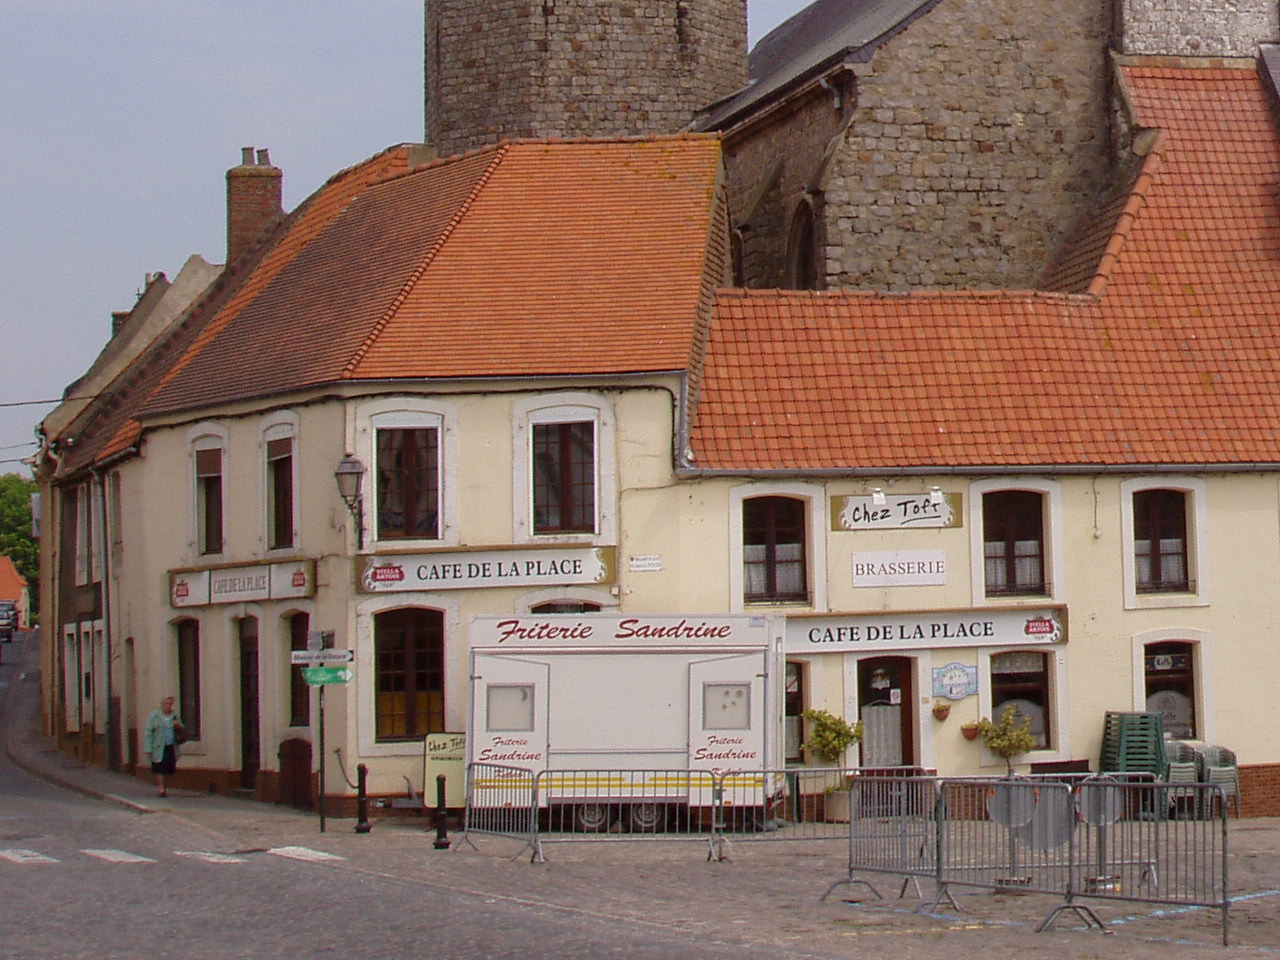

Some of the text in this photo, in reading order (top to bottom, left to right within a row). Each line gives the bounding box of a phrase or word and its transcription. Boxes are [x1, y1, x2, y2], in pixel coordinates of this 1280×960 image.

[852, 503, 892, 523] Chez
[417, 559, 583, 581] CAFE DE LA PLACE
[855, 560, 945, 576] BRASSERIE
[496, 618, 732, 644] Friterie Sandrine
[808, 622, 994, 643] CAFE DE LA PLACE
[492, 736, 528, 747] Friterie
[707, 735, 743, 747] Friterie
[479, 749, 542, 761] Sandrine
[694, 748, 756, 760] Sandrine
